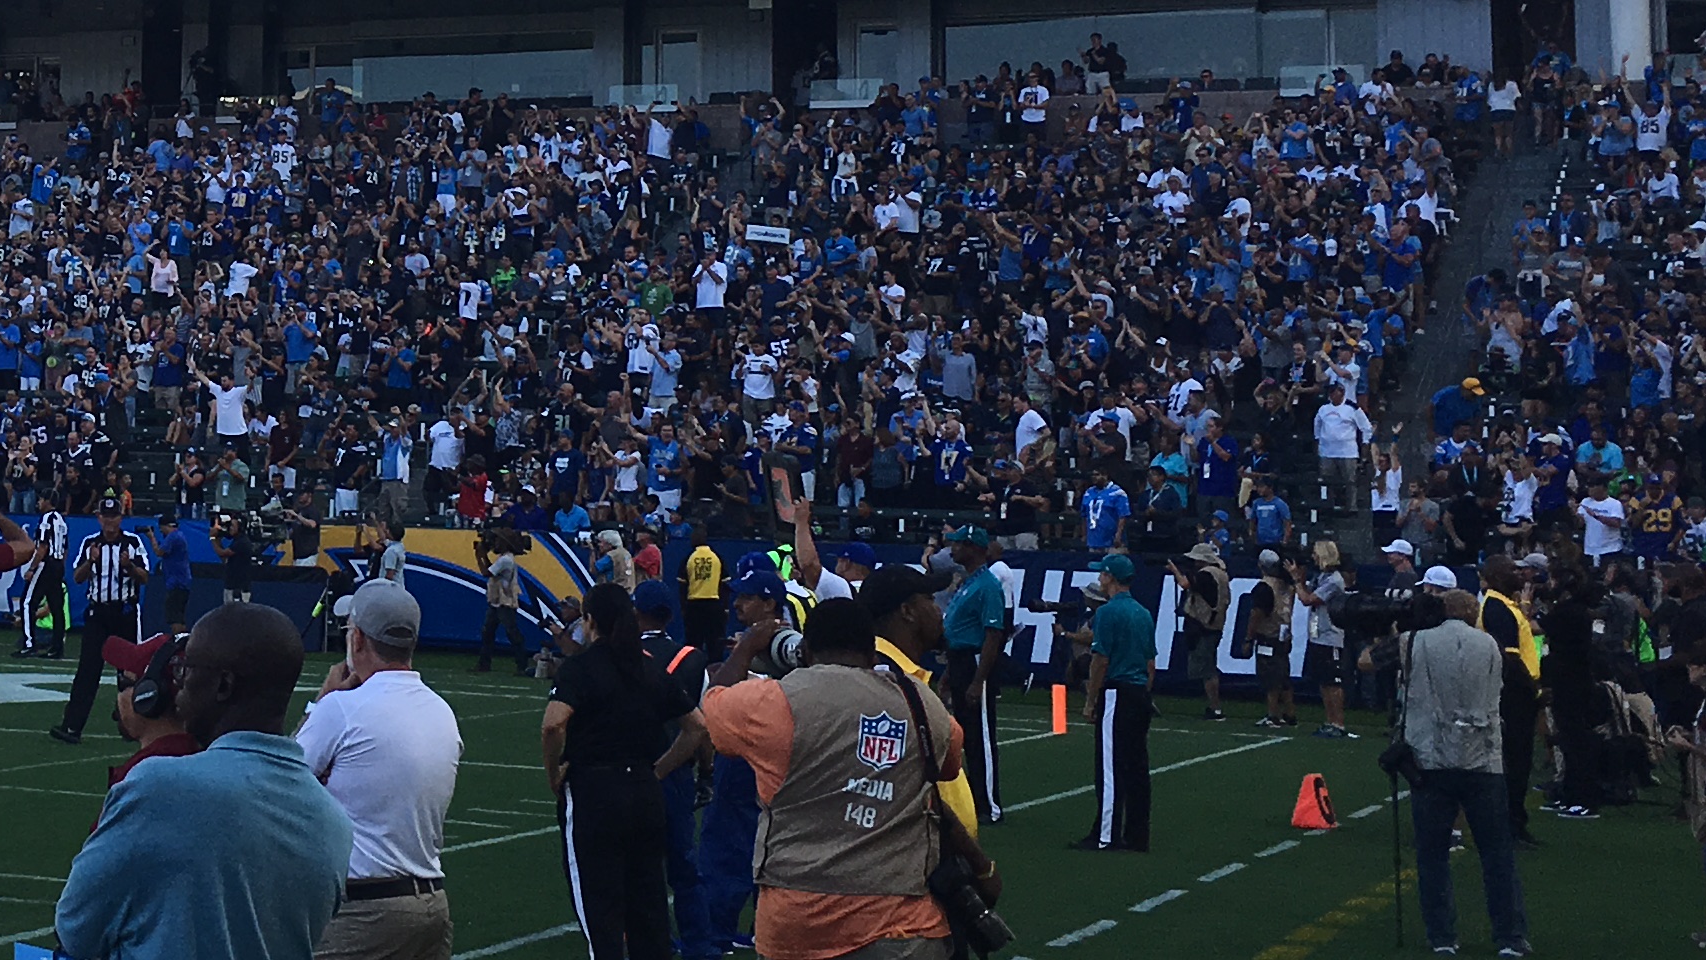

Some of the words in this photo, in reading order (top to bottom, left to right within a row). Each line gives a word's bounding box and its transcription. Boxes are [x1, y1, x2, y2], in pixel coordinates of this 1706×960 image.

[272, 150, 289, 164] 85
[1643, 509, 1673, 533] 29
[862, 736, 898, 763] NFL
[843, 777, 895, 801] MEDIA
[844, 802, 877, 828] 148
